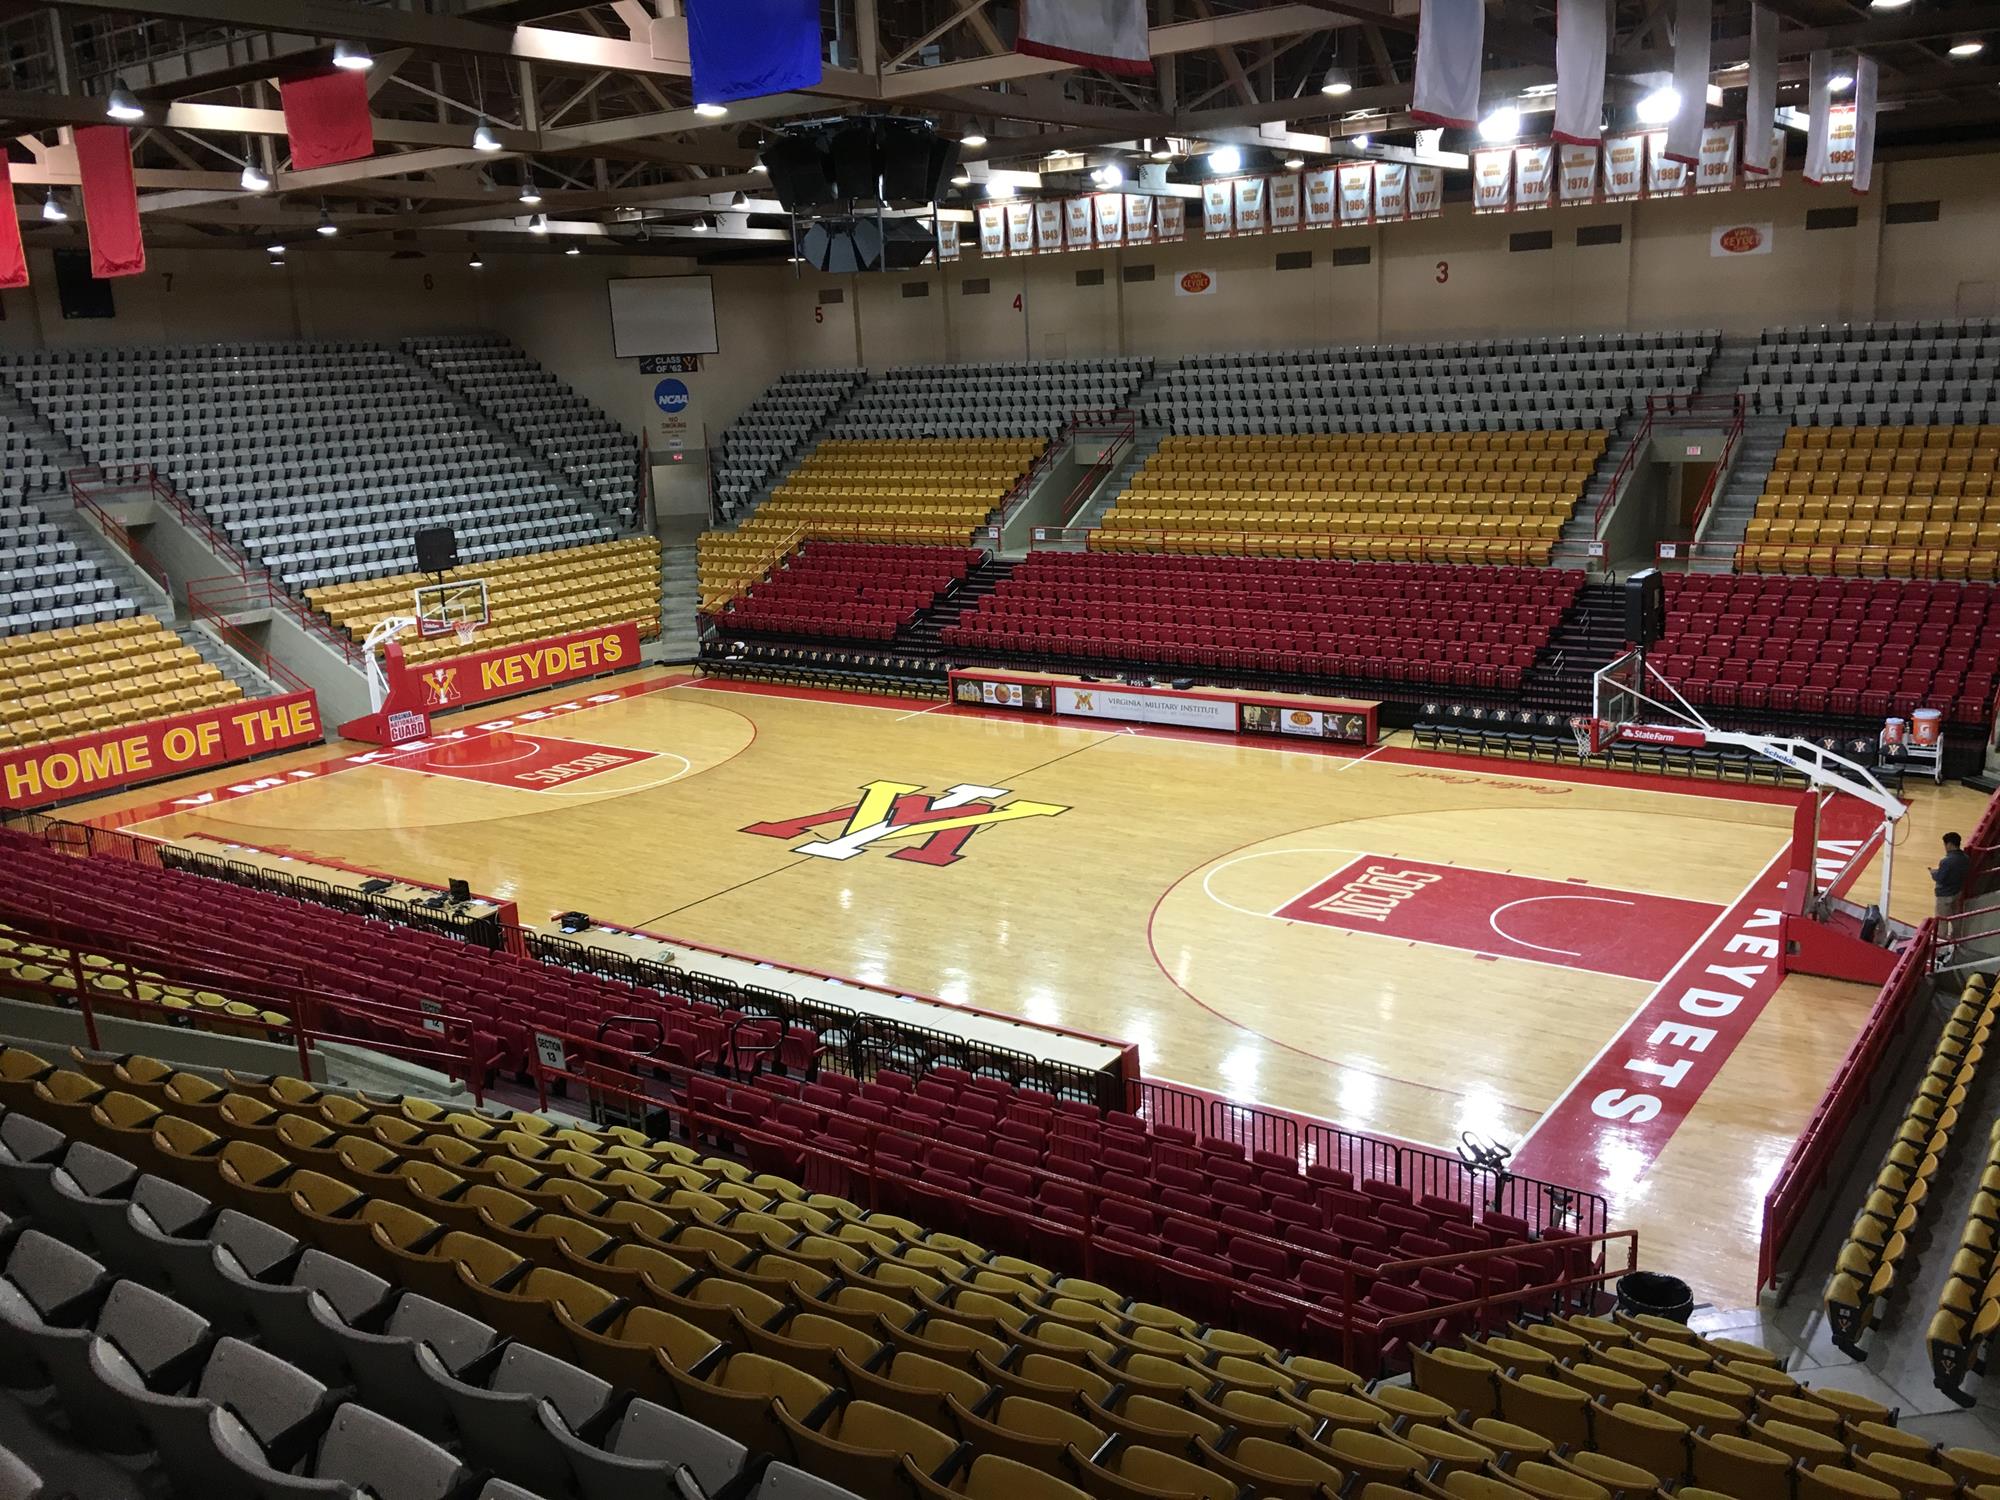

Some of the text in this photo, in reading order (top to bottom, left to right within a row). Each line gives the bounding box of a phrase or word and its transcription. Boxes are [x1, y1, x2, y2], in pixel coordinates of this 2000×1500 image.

[1829, 150, 1856, 163] 1992
[1567, 177, 1588, 190] 1978
[1612, 172, 1633, 186] 1981
[1481, 185, 1501, 198] 1977
[1523, 181, 1544, 194] 1978
[1416, 191, 1435, 204] 1977
[1436, 261, 1449, 283] 3
[162, 273, 173, 292] 7
[424, 274, 434, 290] 6
[1013, 294, 1022, 312] 4
[815, 307, 824, 323] 5
[655, 356, 681, 365] CLASS
[656, 365, 667, 373] OF
[658, 395, 688, 405] NCAA
[480, 635, 623, 690] KEYDETS
[1108, 698, 1141, 707] VIRGINIA
[1145, 701, 1178, 711] MILITARY
[1180, 705, 1219, 715] INSTITUTE
[390, 711, 411, 721] VIRGINIA
[391, 721, 425, 740] GUARD
[3, 700, 316, 799] HOME OF THE
[170, 694, 622, 805] VMI KEYDETS
[1763, 746, 1797, 767] Schelde
[514, 752, 633, 784] SOCON
[1308, 865, 1443, 922] SOCON
[537, 1036, 562, 1052] SECTION
[546, 1051, 557, 1062] 13
